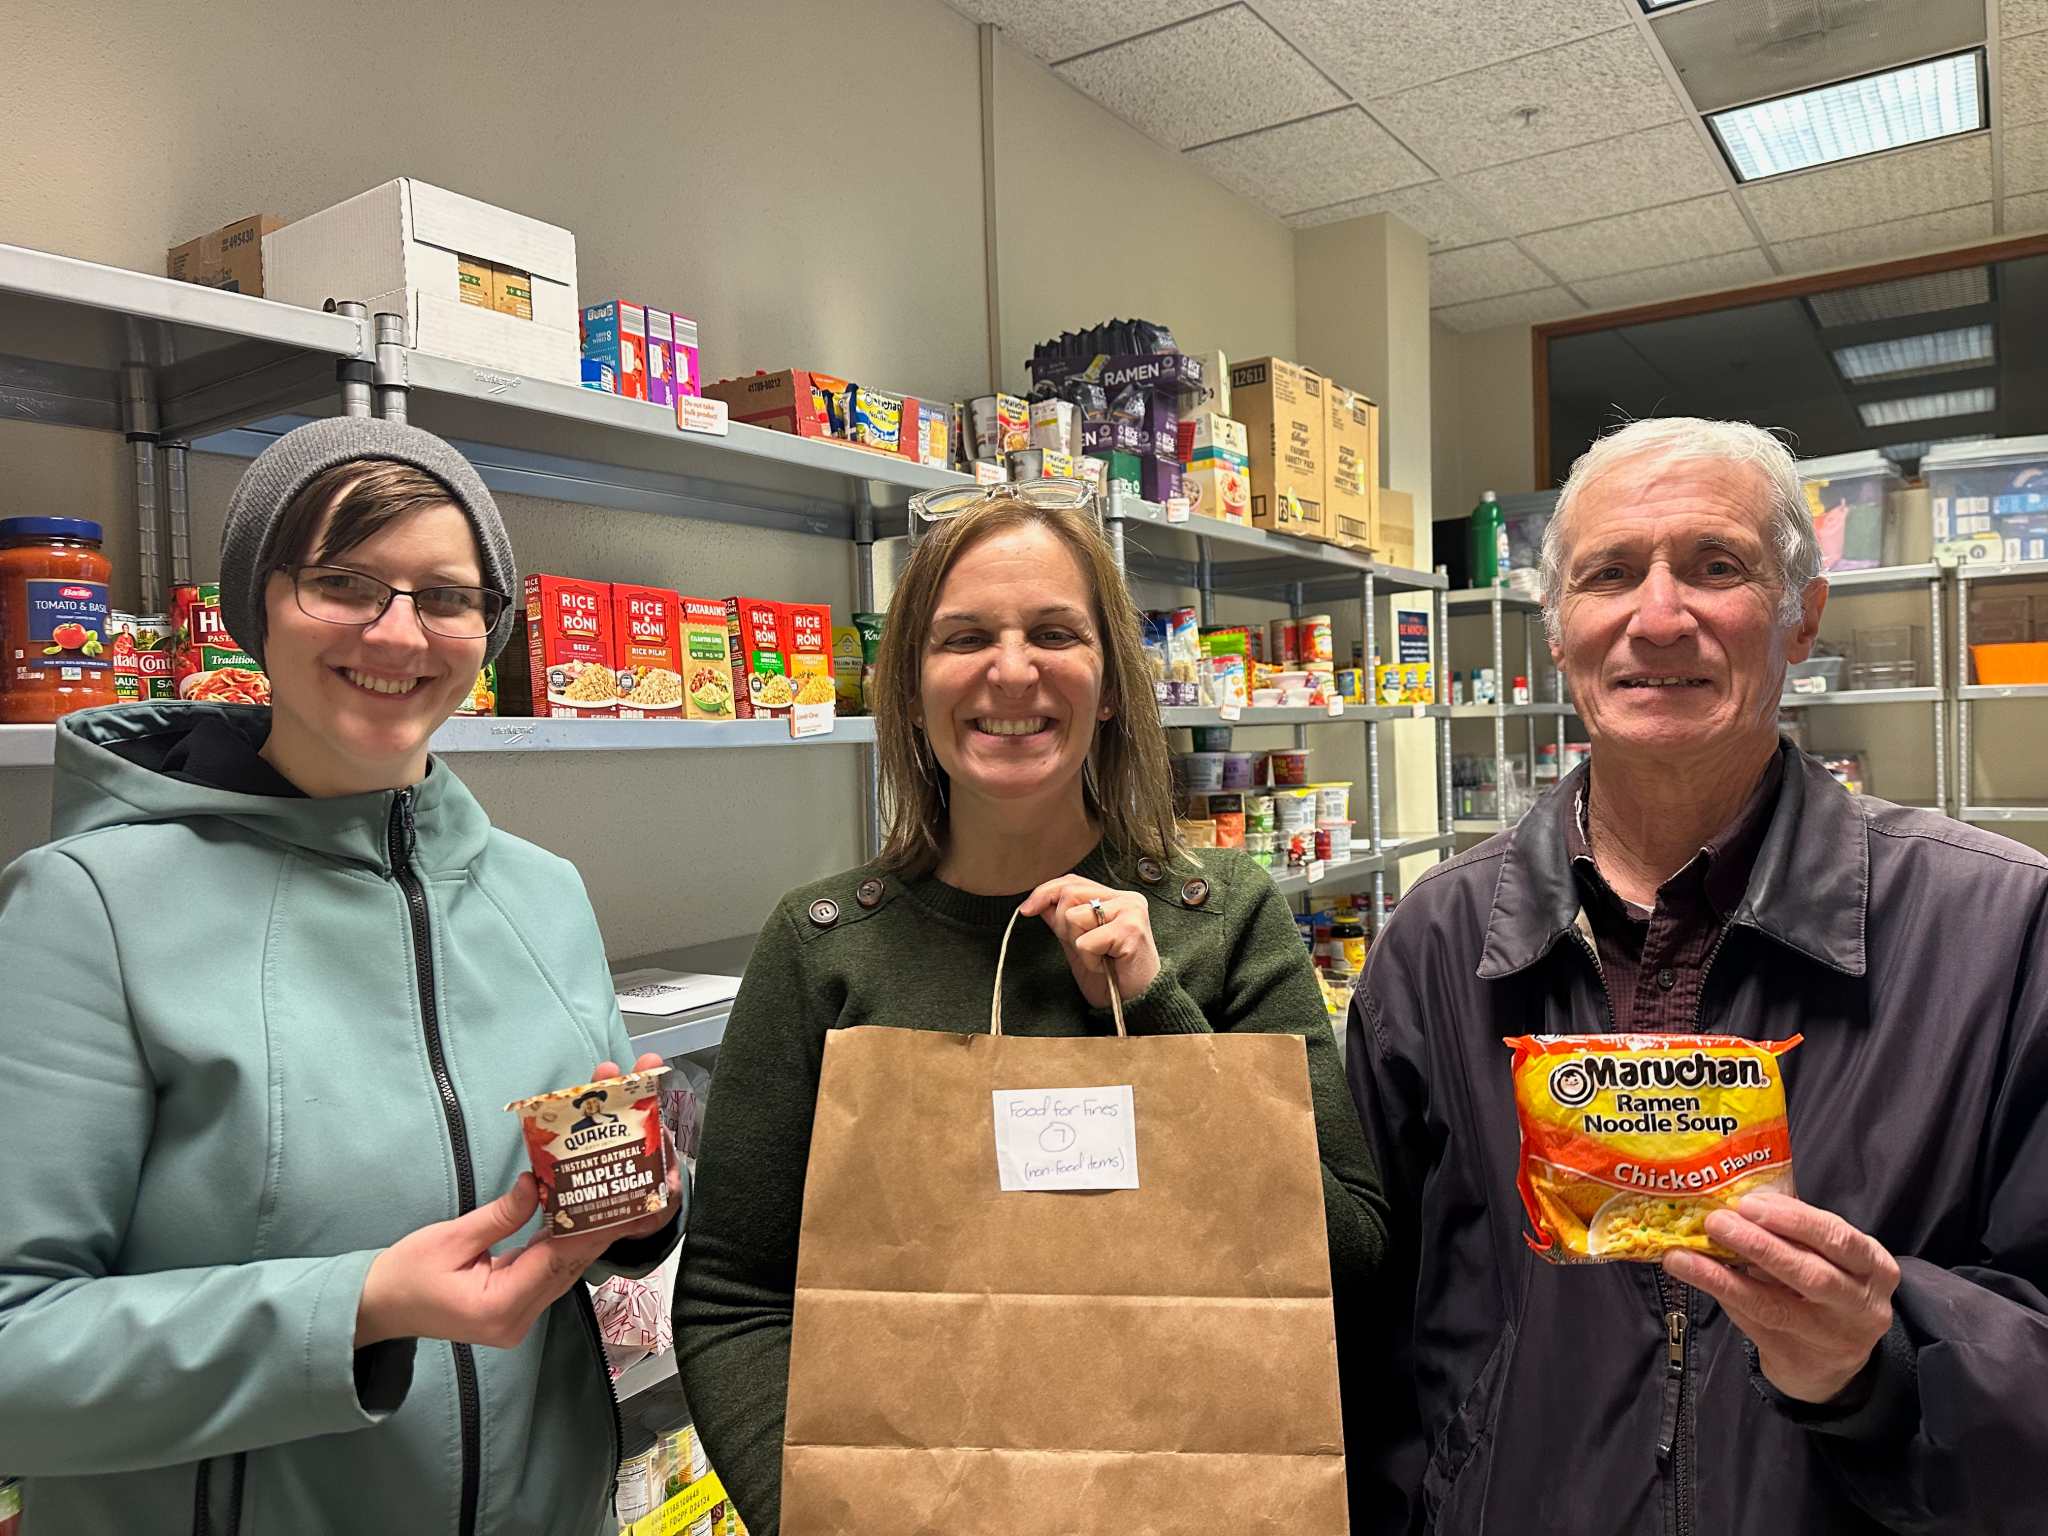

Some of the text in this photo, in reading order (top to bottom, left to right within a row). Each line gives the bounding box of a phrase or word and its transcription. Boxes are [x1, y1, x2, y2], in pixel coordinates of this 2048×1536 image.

[229, 228, 254, 249] 495430
[1104, 363, 1159, 387] RAMEN
[1234, 366, 1264, 386] 12611
[697, 411, 717, 419] product
[524, 578, 538, 587] RICE
[63, 588, 91, 597] Barilla
[35, 600, 108, 613] TOMATO & BASIL
[561, 593, 595, 610] RICE
[631, 601, 663, 616] RICE
[687, 603, 726, 616] ZATARAIN'S
[563, 615, 597, 631] RONI
[752, 611, 774, 625] RICE
[795, 616, 820, 628] RICE
[632, 621, 664, 636] RONI
[755, 629, 776, 643] RONI
[573, 643, 590, 651] BEEF
[796, 634, 821, 645] RONI
[211, 655, 256, 665] Tradition
[1584, 1053, 1761, 1088] Maruchan
[1010, 1096, 1118, 1118] Food for Fines
[1617, 1094, 1700, 1112] Ramen
[1584, 1113, 1737, 1136] Noodle Soup
[564, 1124, 627, 1151] QUAKER
[1053, 1128, 1066, 1144] 7
[560, 1145, 641, 1174] INSTANT OATMEAL
[571, 1159, 637, 1188] MAPLE &
[1613, 1147, 1772, 1191] Chicken Flavor
[557, 1170, 654, 1207] BROWN SUGAR
